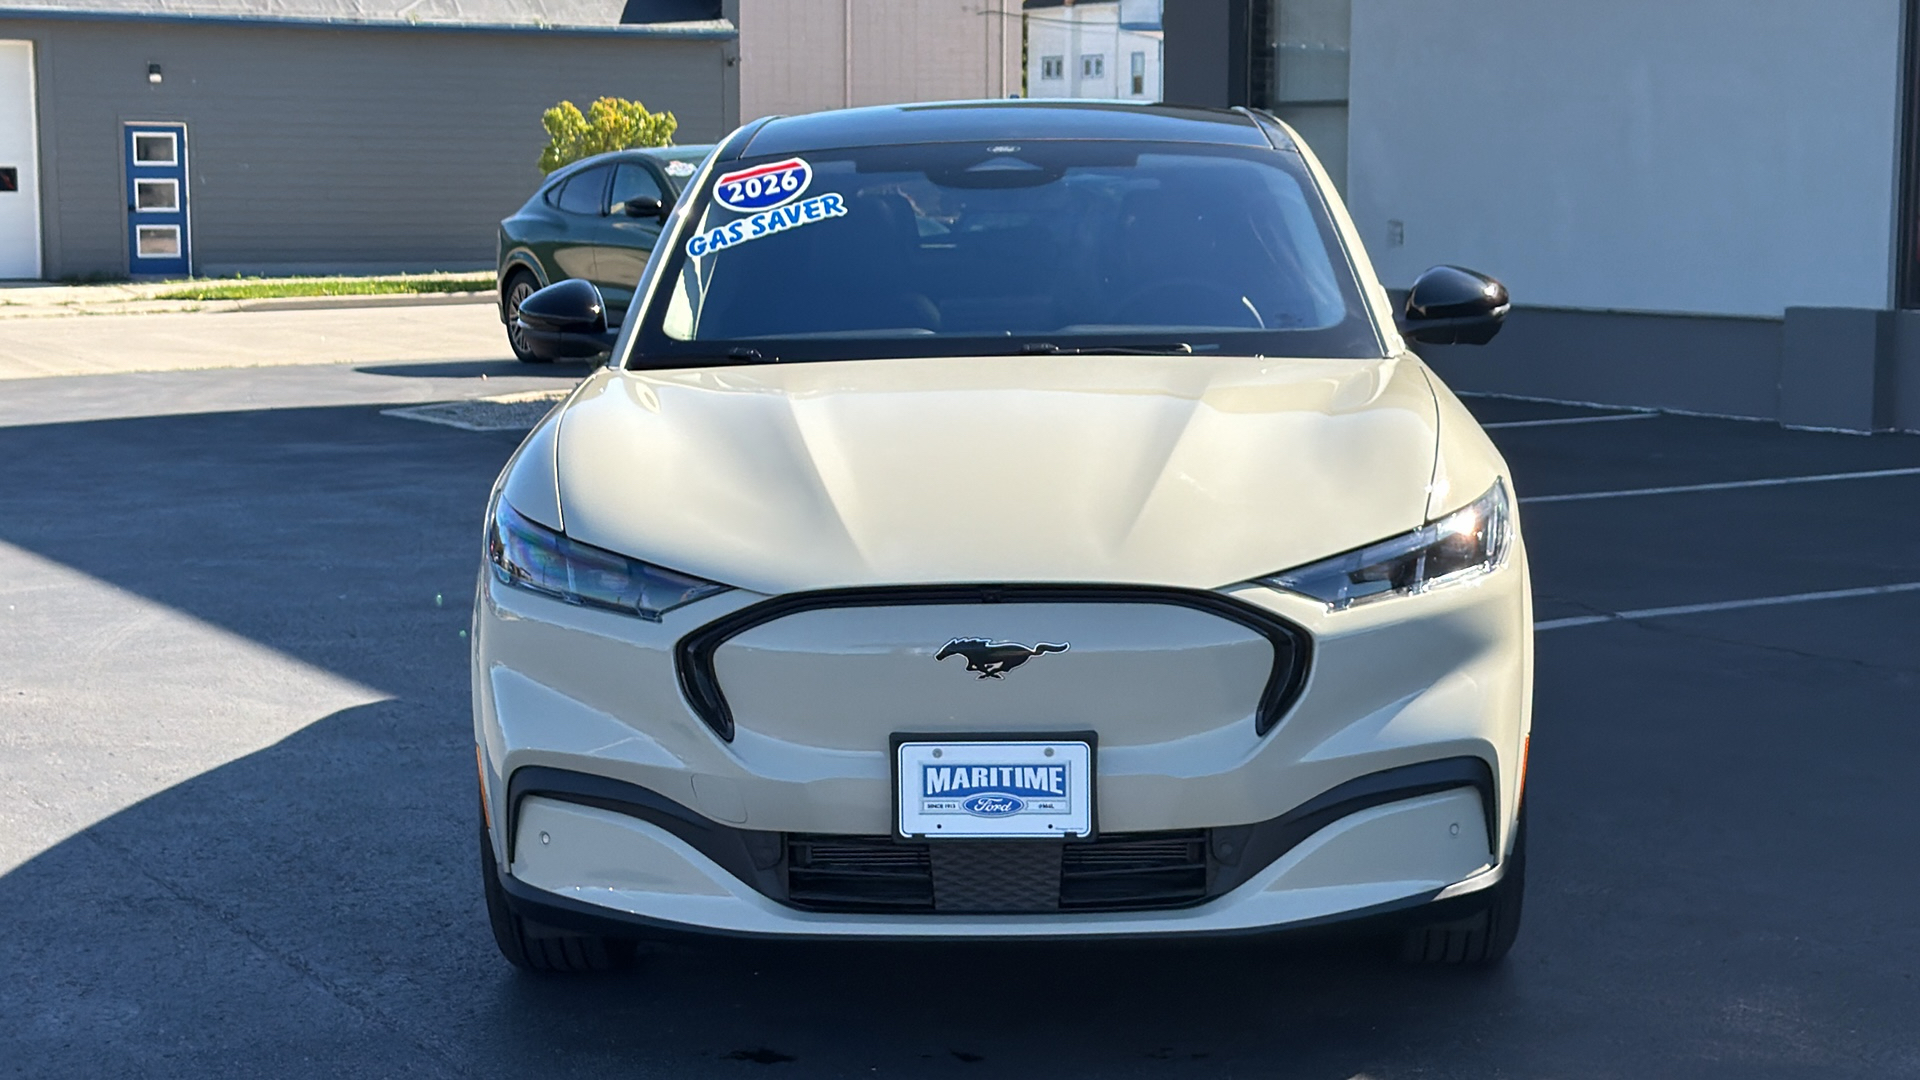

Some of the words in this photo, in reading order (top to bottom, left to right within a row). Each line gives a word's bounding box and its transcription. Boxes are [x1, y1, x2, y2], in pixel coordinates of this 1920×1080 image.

[727, 171, 798, 203] 2026
[688, 221, 744, 256] GAS
[751, 195, 843, 236] SAVER
[926, 767, 1064, 794] MARITIME
[974, 798, 1013, 812] Ford
